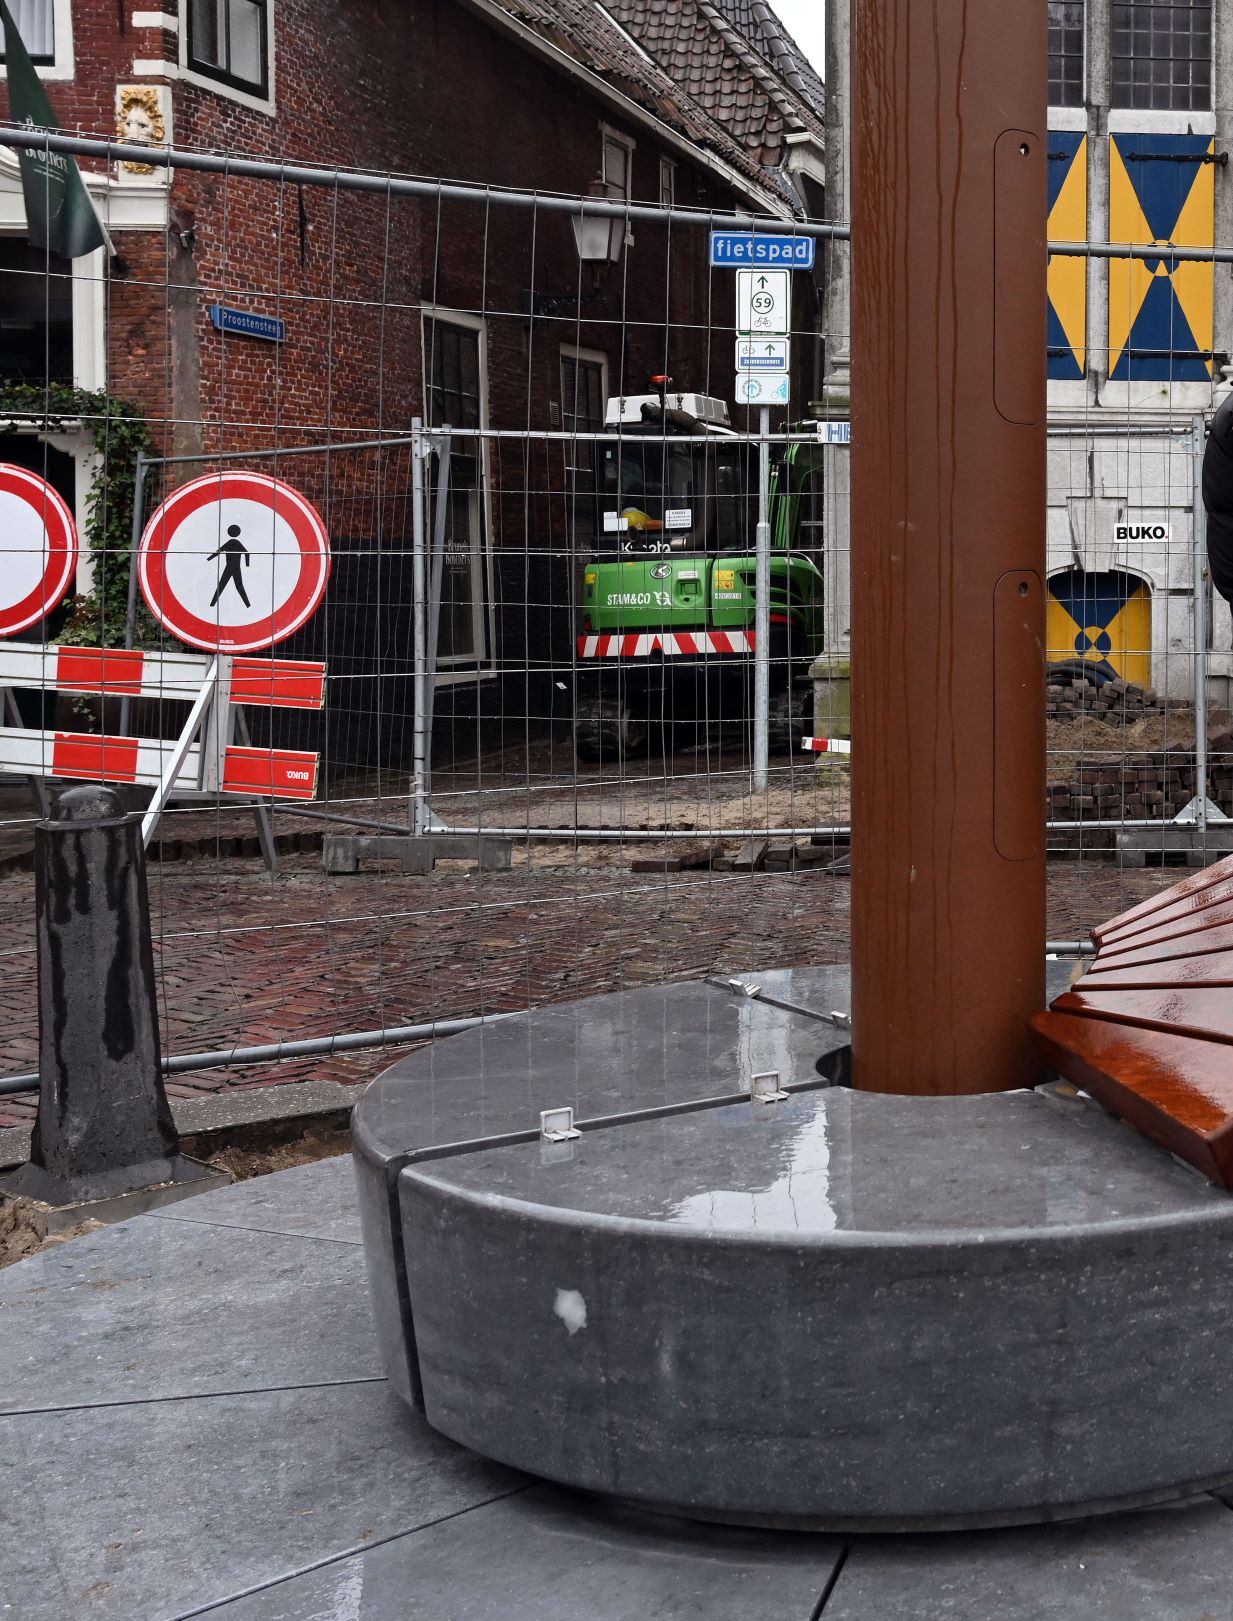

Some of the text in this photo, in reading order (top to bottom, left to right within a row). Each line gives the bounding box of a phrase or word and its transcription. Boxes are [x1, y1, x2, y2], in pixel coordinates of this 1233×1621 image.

[716, 239, 807, 261] fietspad
[754, 297, 772, 309] 59
[607, 592, 651, 606] STAM&CO
